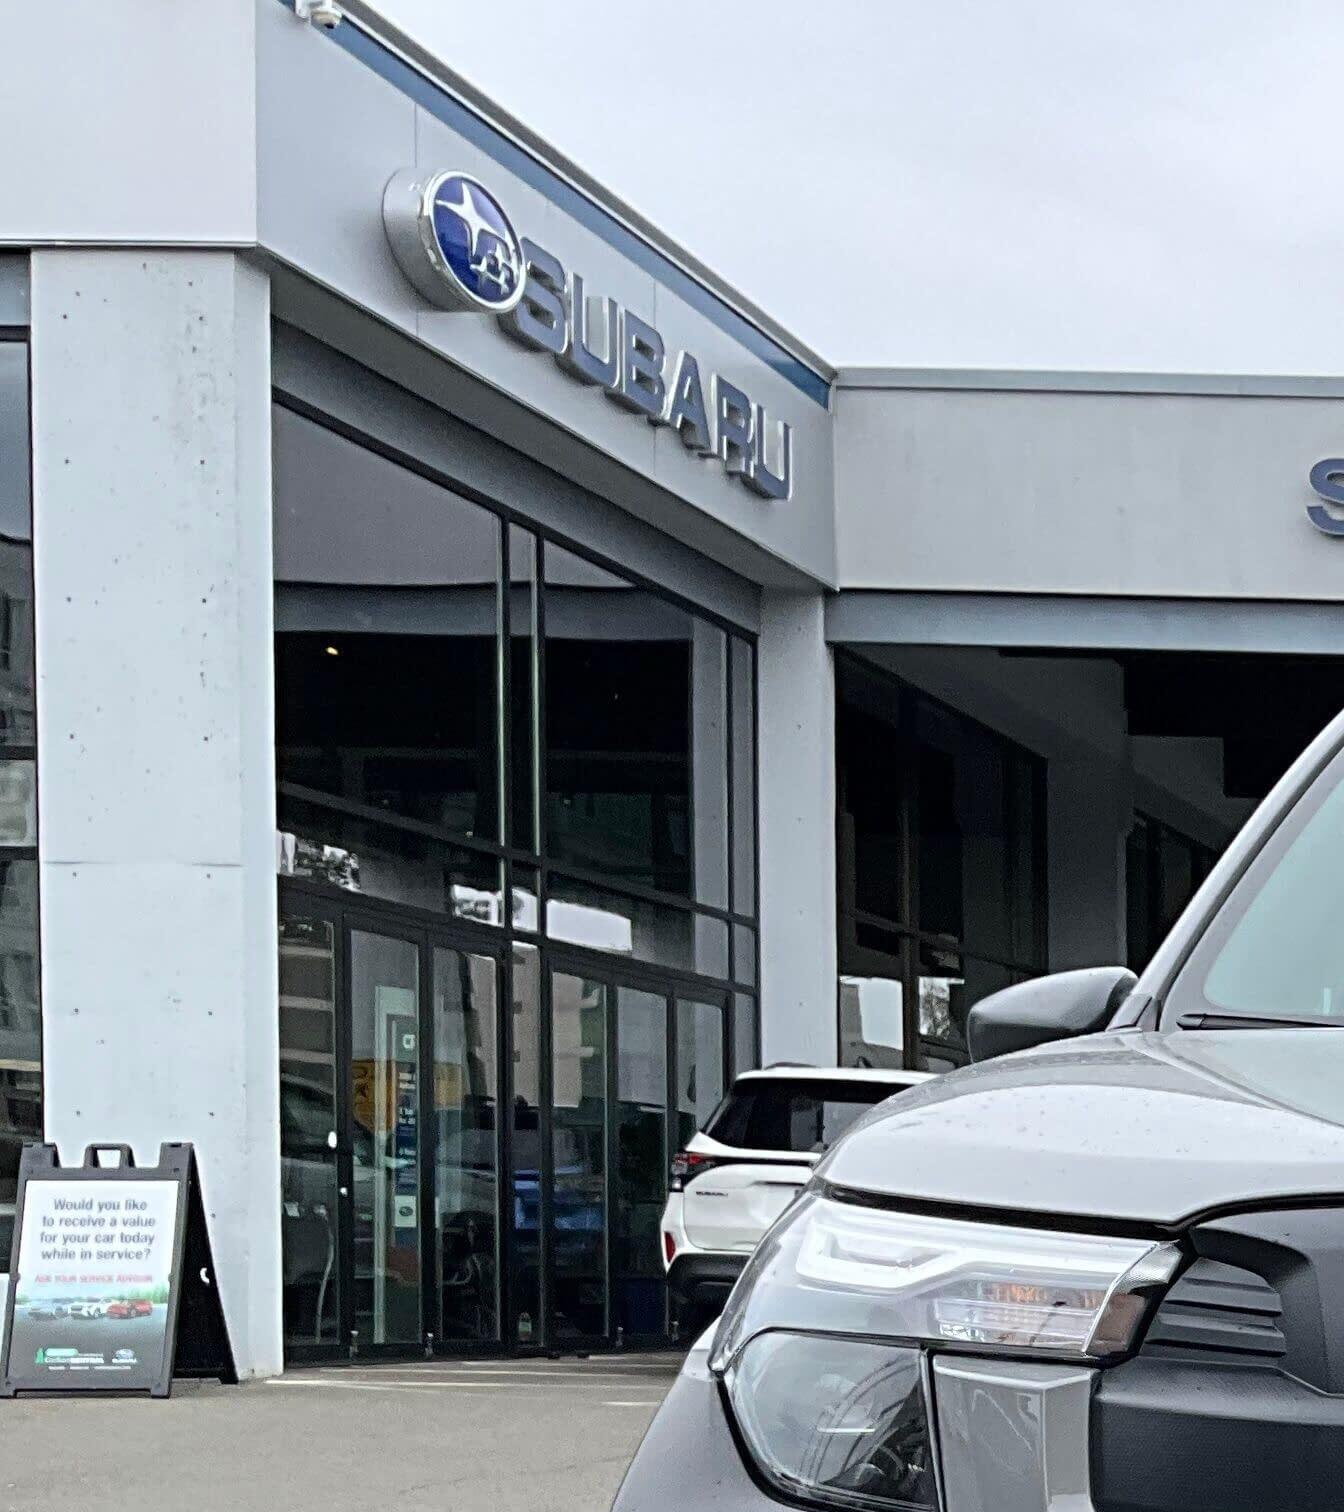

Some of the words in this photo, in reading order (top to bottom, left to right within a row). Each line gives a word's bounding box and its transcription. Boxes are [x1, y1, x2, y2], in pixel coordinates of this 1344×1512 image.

[508, 236, 794, 502] SUBARU
[54, 1198, 94, 1211] Would
[98, 1201, 121, 1213] you
[124, 1198, 148, 1211] like
[42, 1215, 55, 1227] to
[59, 1215, 106, 1227] receive
[109, 1217, 118, 1227] a
[122, 1215, 156, 1227] value
[40, 1231, 58, 1243] for
[62, 1233, 91, 1246] your
[95, 1233, 115, 1243] car
[120, 1231, 155, 1246] today
[41, 1248, 76, 1260] while
[80, 1248, 92, 1260] in
[96, 1248, 151, 1260] service?
